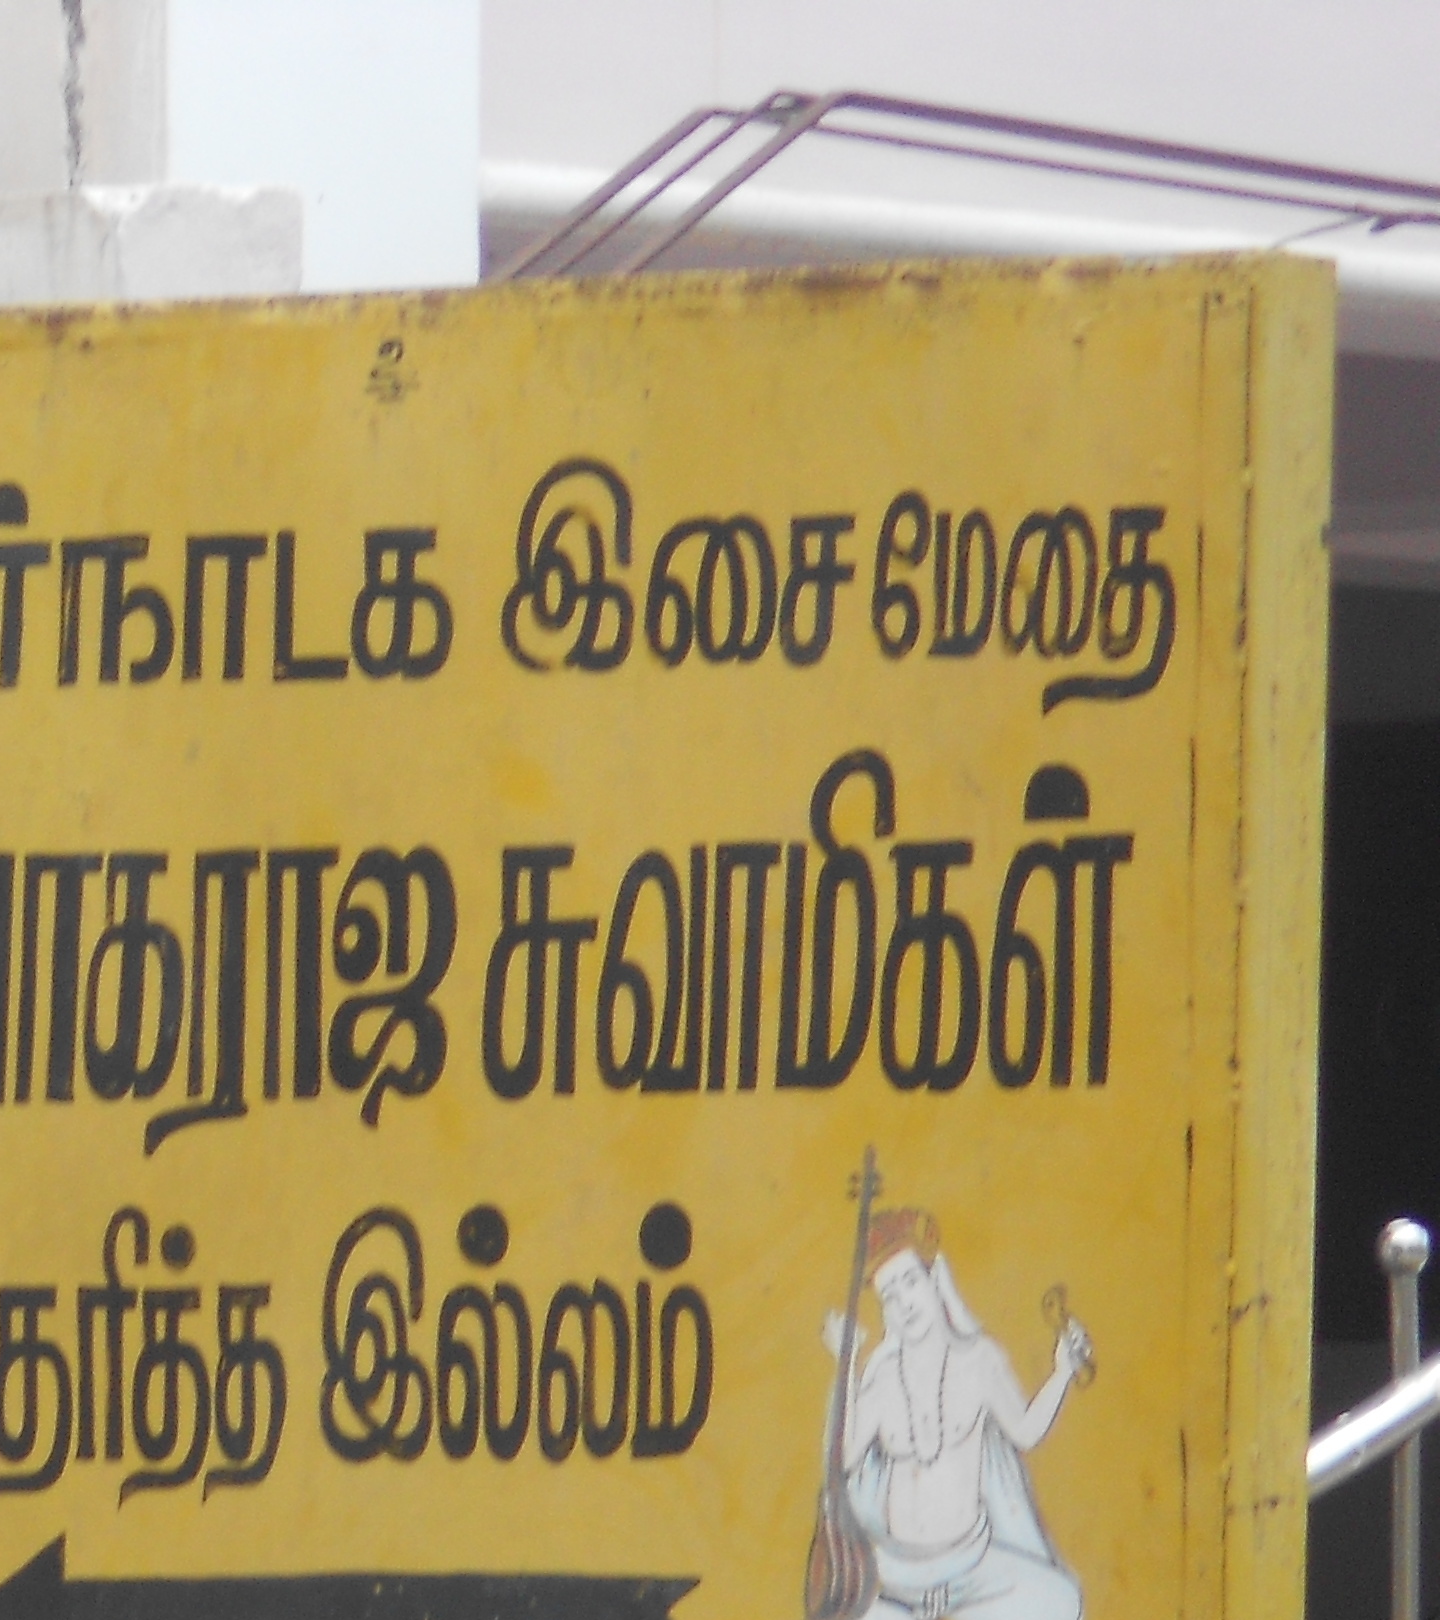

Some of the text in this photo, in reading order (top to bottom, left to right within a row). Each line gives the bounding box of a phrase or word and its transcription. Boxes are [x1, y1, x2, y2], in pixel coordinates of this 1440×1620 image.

[501, 458, 856, 673] இசை
[871, 490, 1176, 716] மேதை
[481, 749, 1135, 1101] சுவாமிகள்
[319, 1202, 713, 1464] இல்லம்
